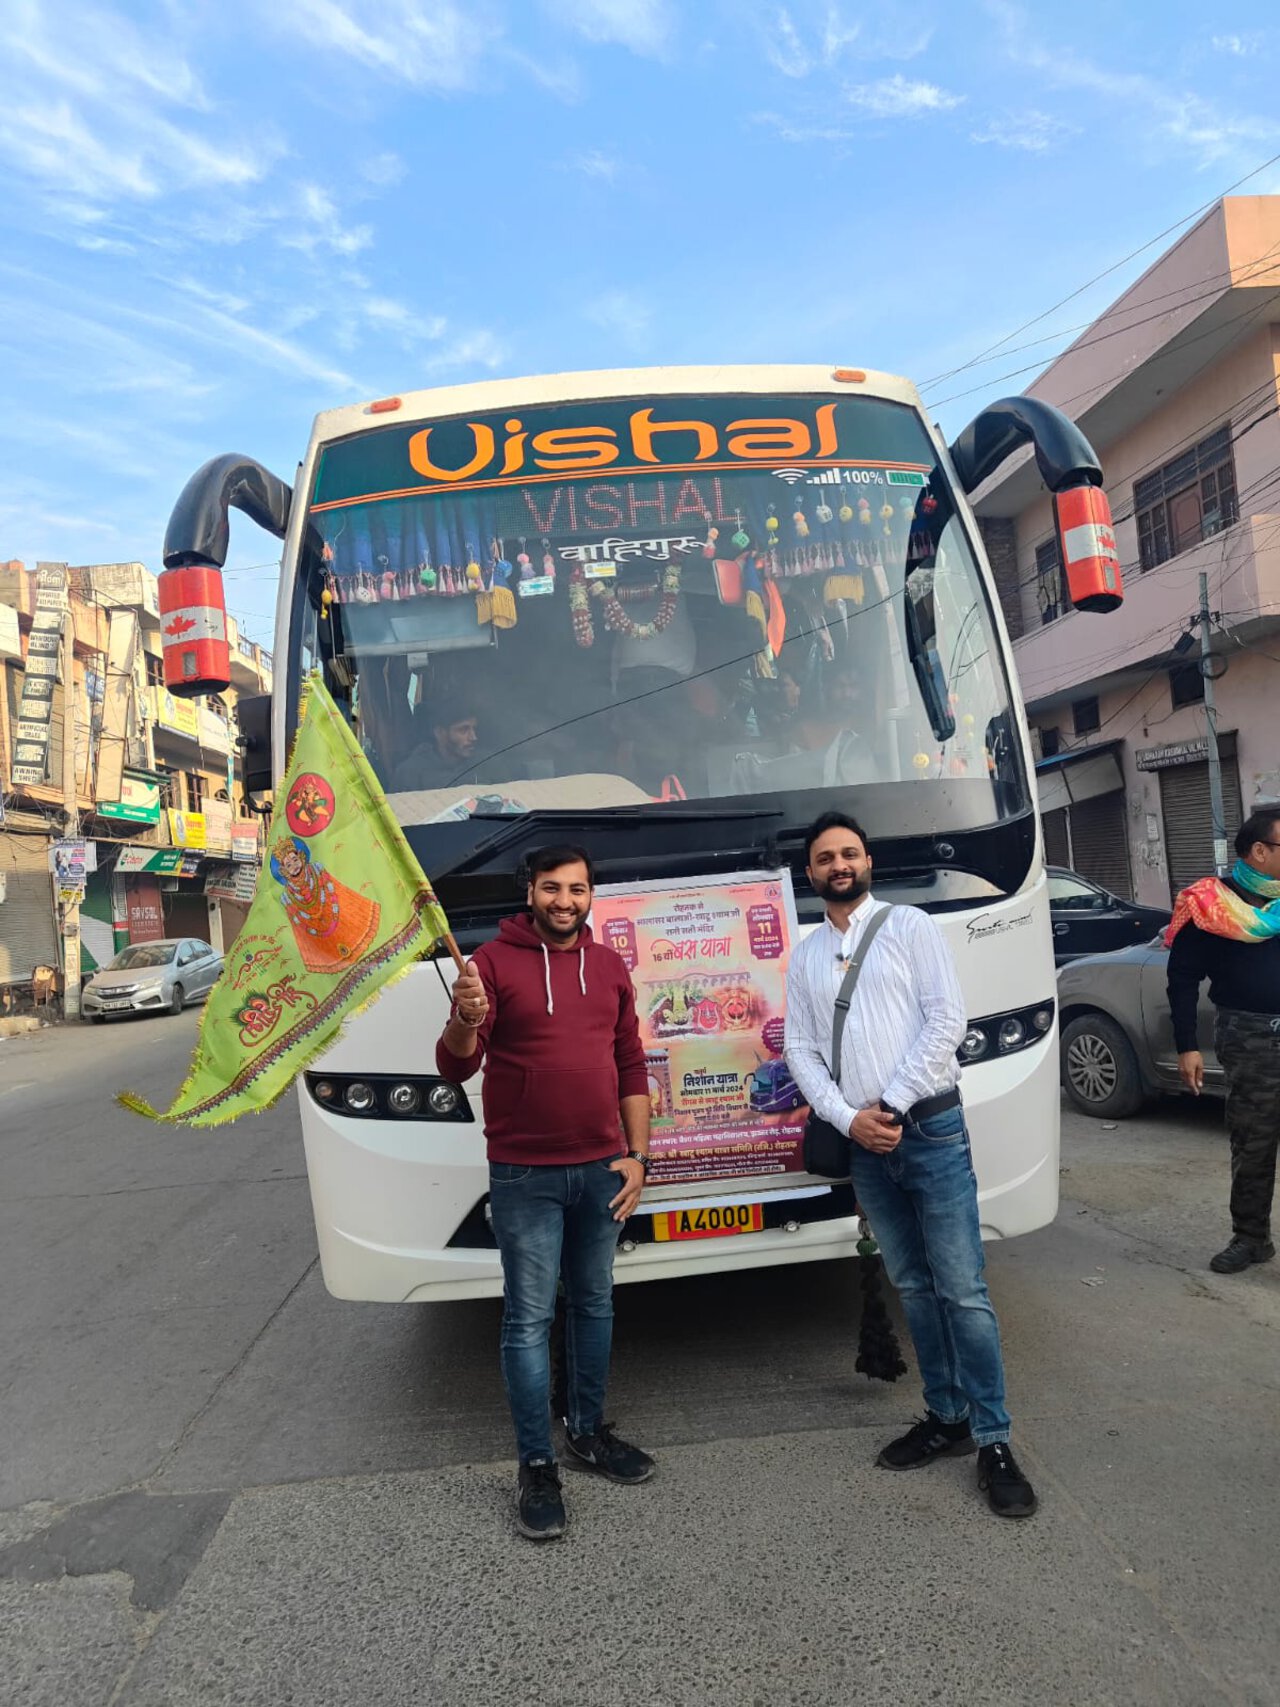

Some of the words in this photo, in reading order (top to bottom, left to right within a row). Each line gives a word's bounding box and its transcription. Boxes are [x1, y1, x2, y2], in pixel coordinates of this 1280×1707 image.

[408, 403, 838, 482] Vishal
[843, 471, 884, 485] 100%
[521, 477, 745, 533] VISHAL
[557, 537, 710, 563] वाहिगुरू
[757, 922, 772, 934] 11
[610, 936, 628, 949] 10
[653, 953, 663, 962] 16
[700, 937, 732, 957] यात्रा
[683, 1073, 715, 1088] निशान
[716, 1073, 738, 1083] यात्रा
